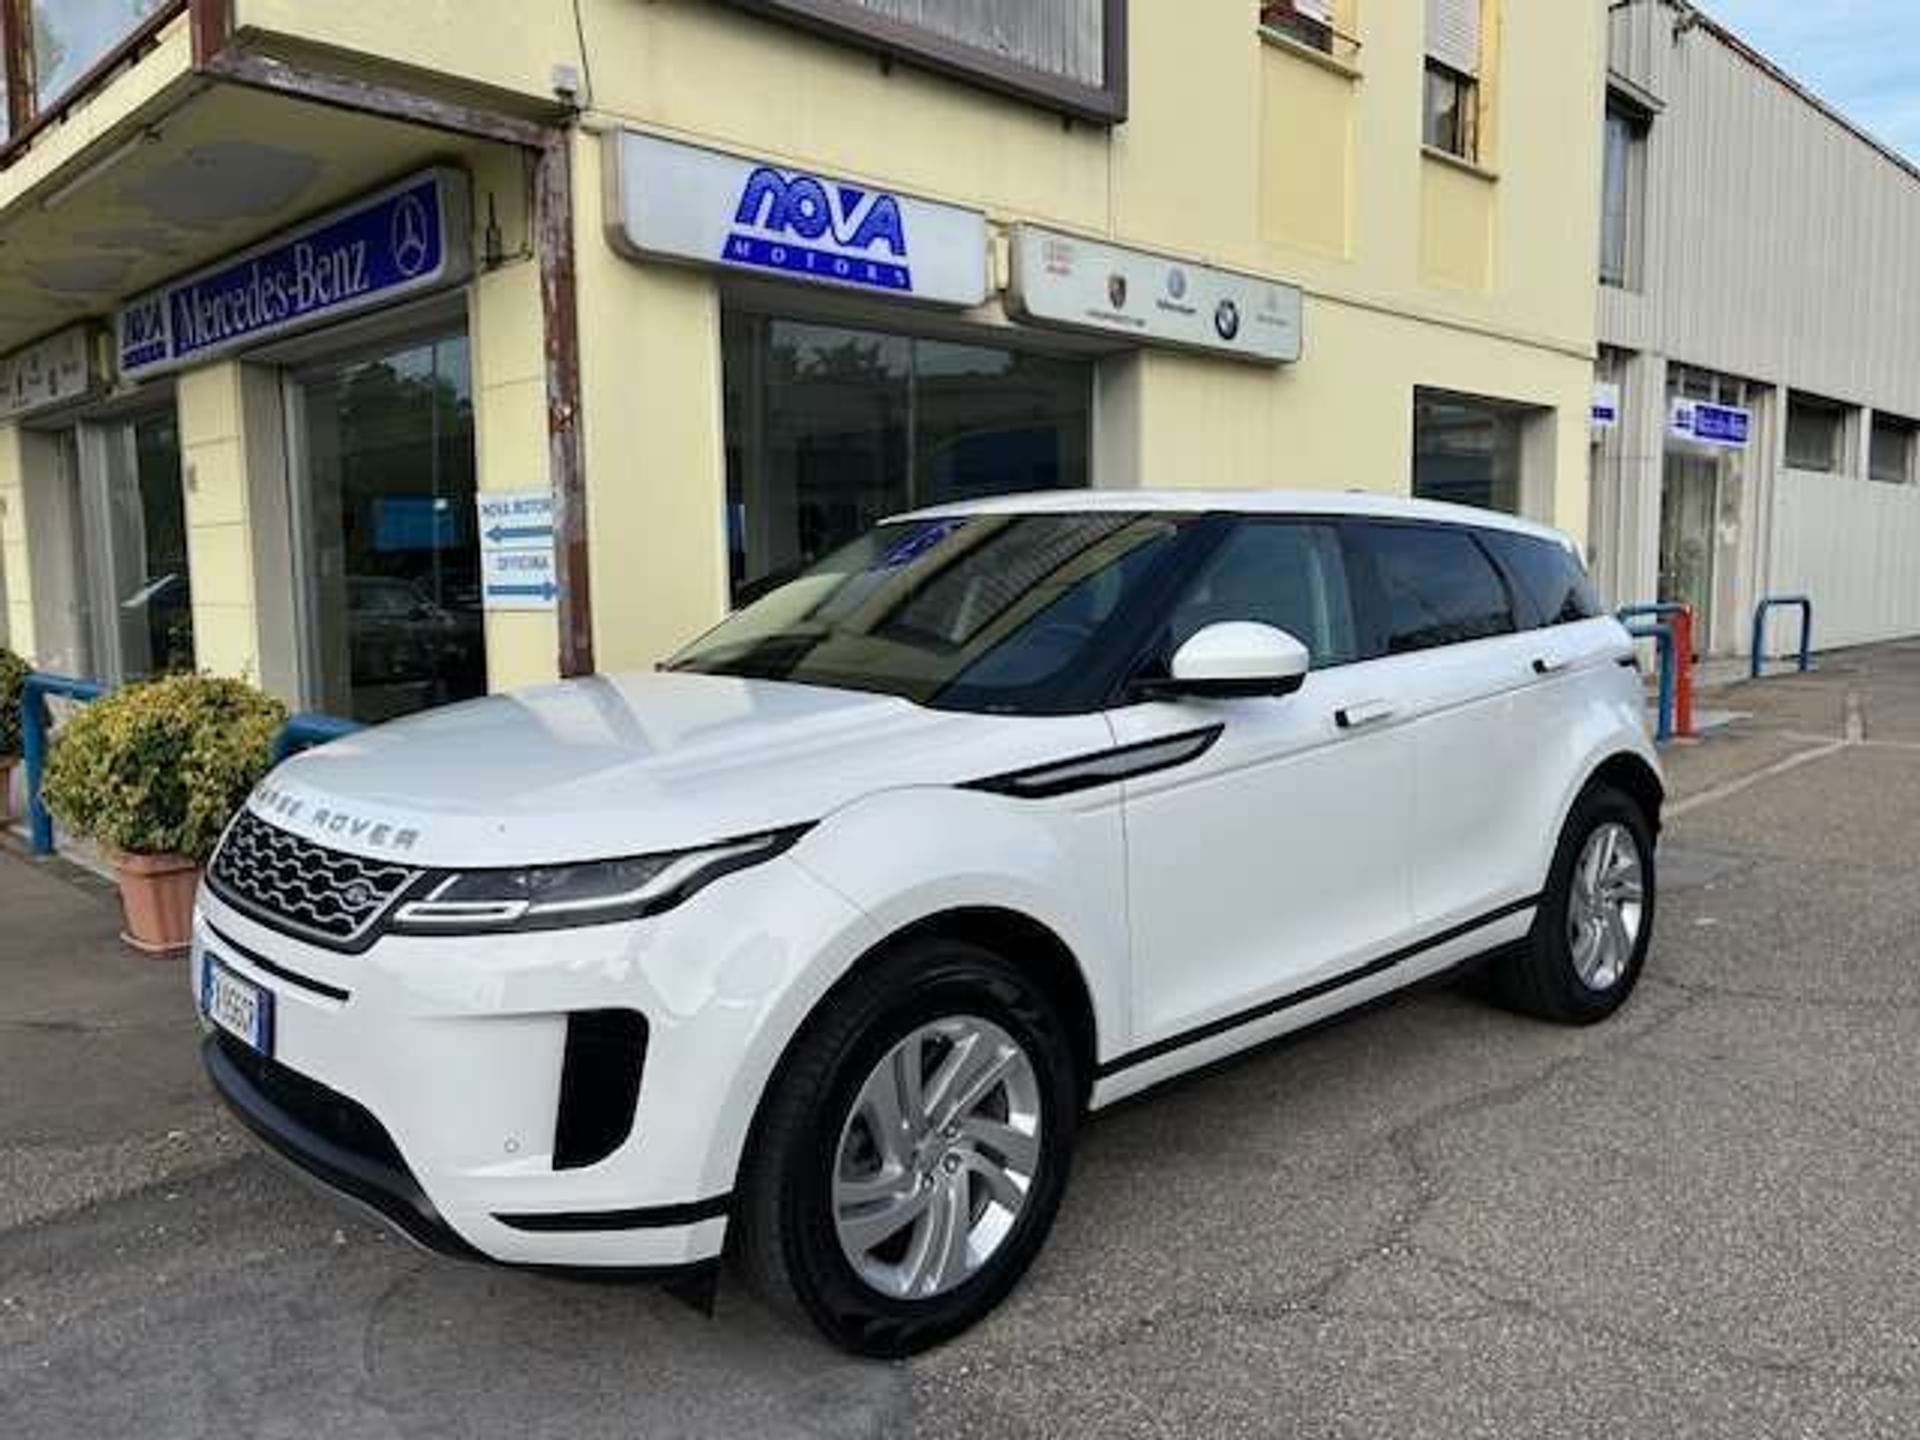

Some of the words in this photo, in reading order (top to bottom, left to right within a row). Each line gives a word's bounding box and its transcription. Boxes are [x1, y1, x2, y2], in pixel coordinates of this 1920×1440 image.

[733, 240, 906, 287] MOTORS
[173, 240, 371, 347] Mercedes-Benz
[312, 809, 420, 850] ROVER
